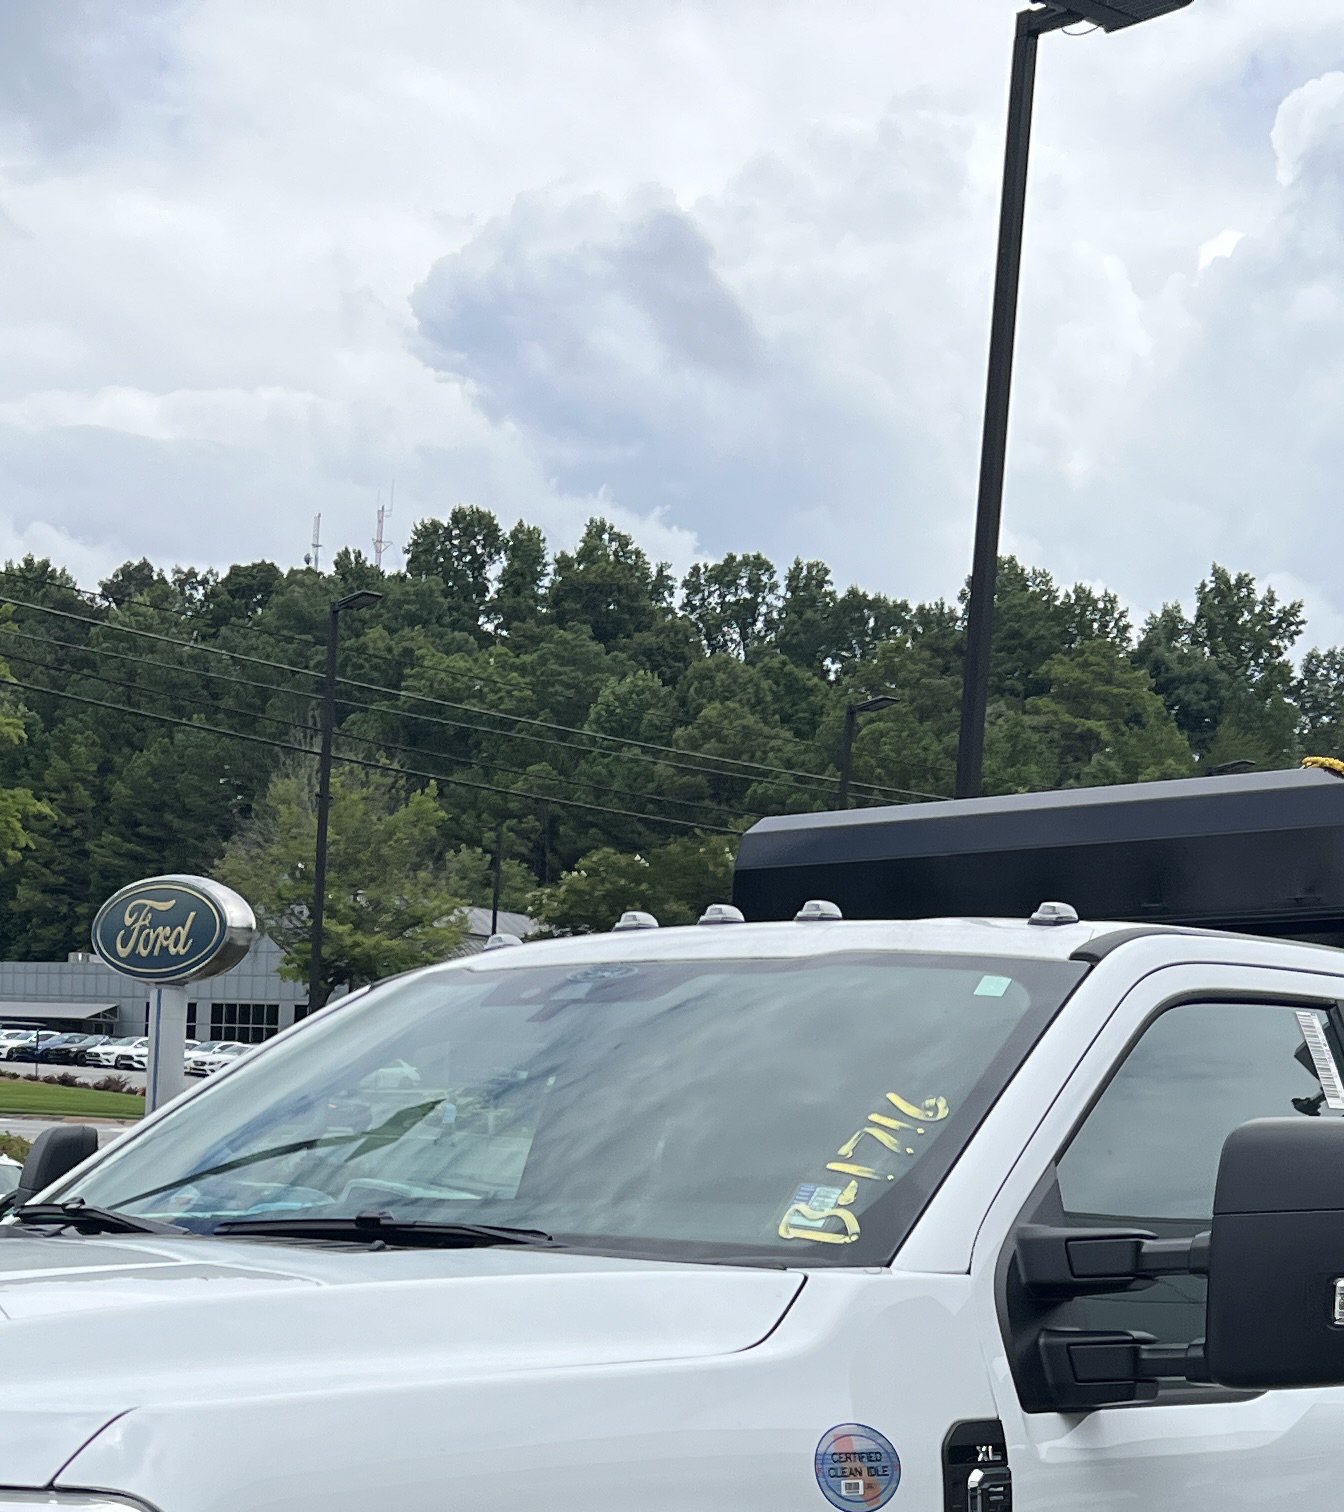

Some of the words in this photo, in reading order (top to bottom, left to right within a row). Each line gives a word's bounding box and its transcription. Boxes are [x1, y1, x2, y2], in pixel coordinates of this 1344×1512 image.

[116, 899, 197, 958] Ford
[831, 1452, 882, 1464] CERTIFIED
[976, 1445, 1002, 1461] XL
[828, 1466, 863, 1478] CLEAN
[867, 1465, 889, 1477] IDLE
